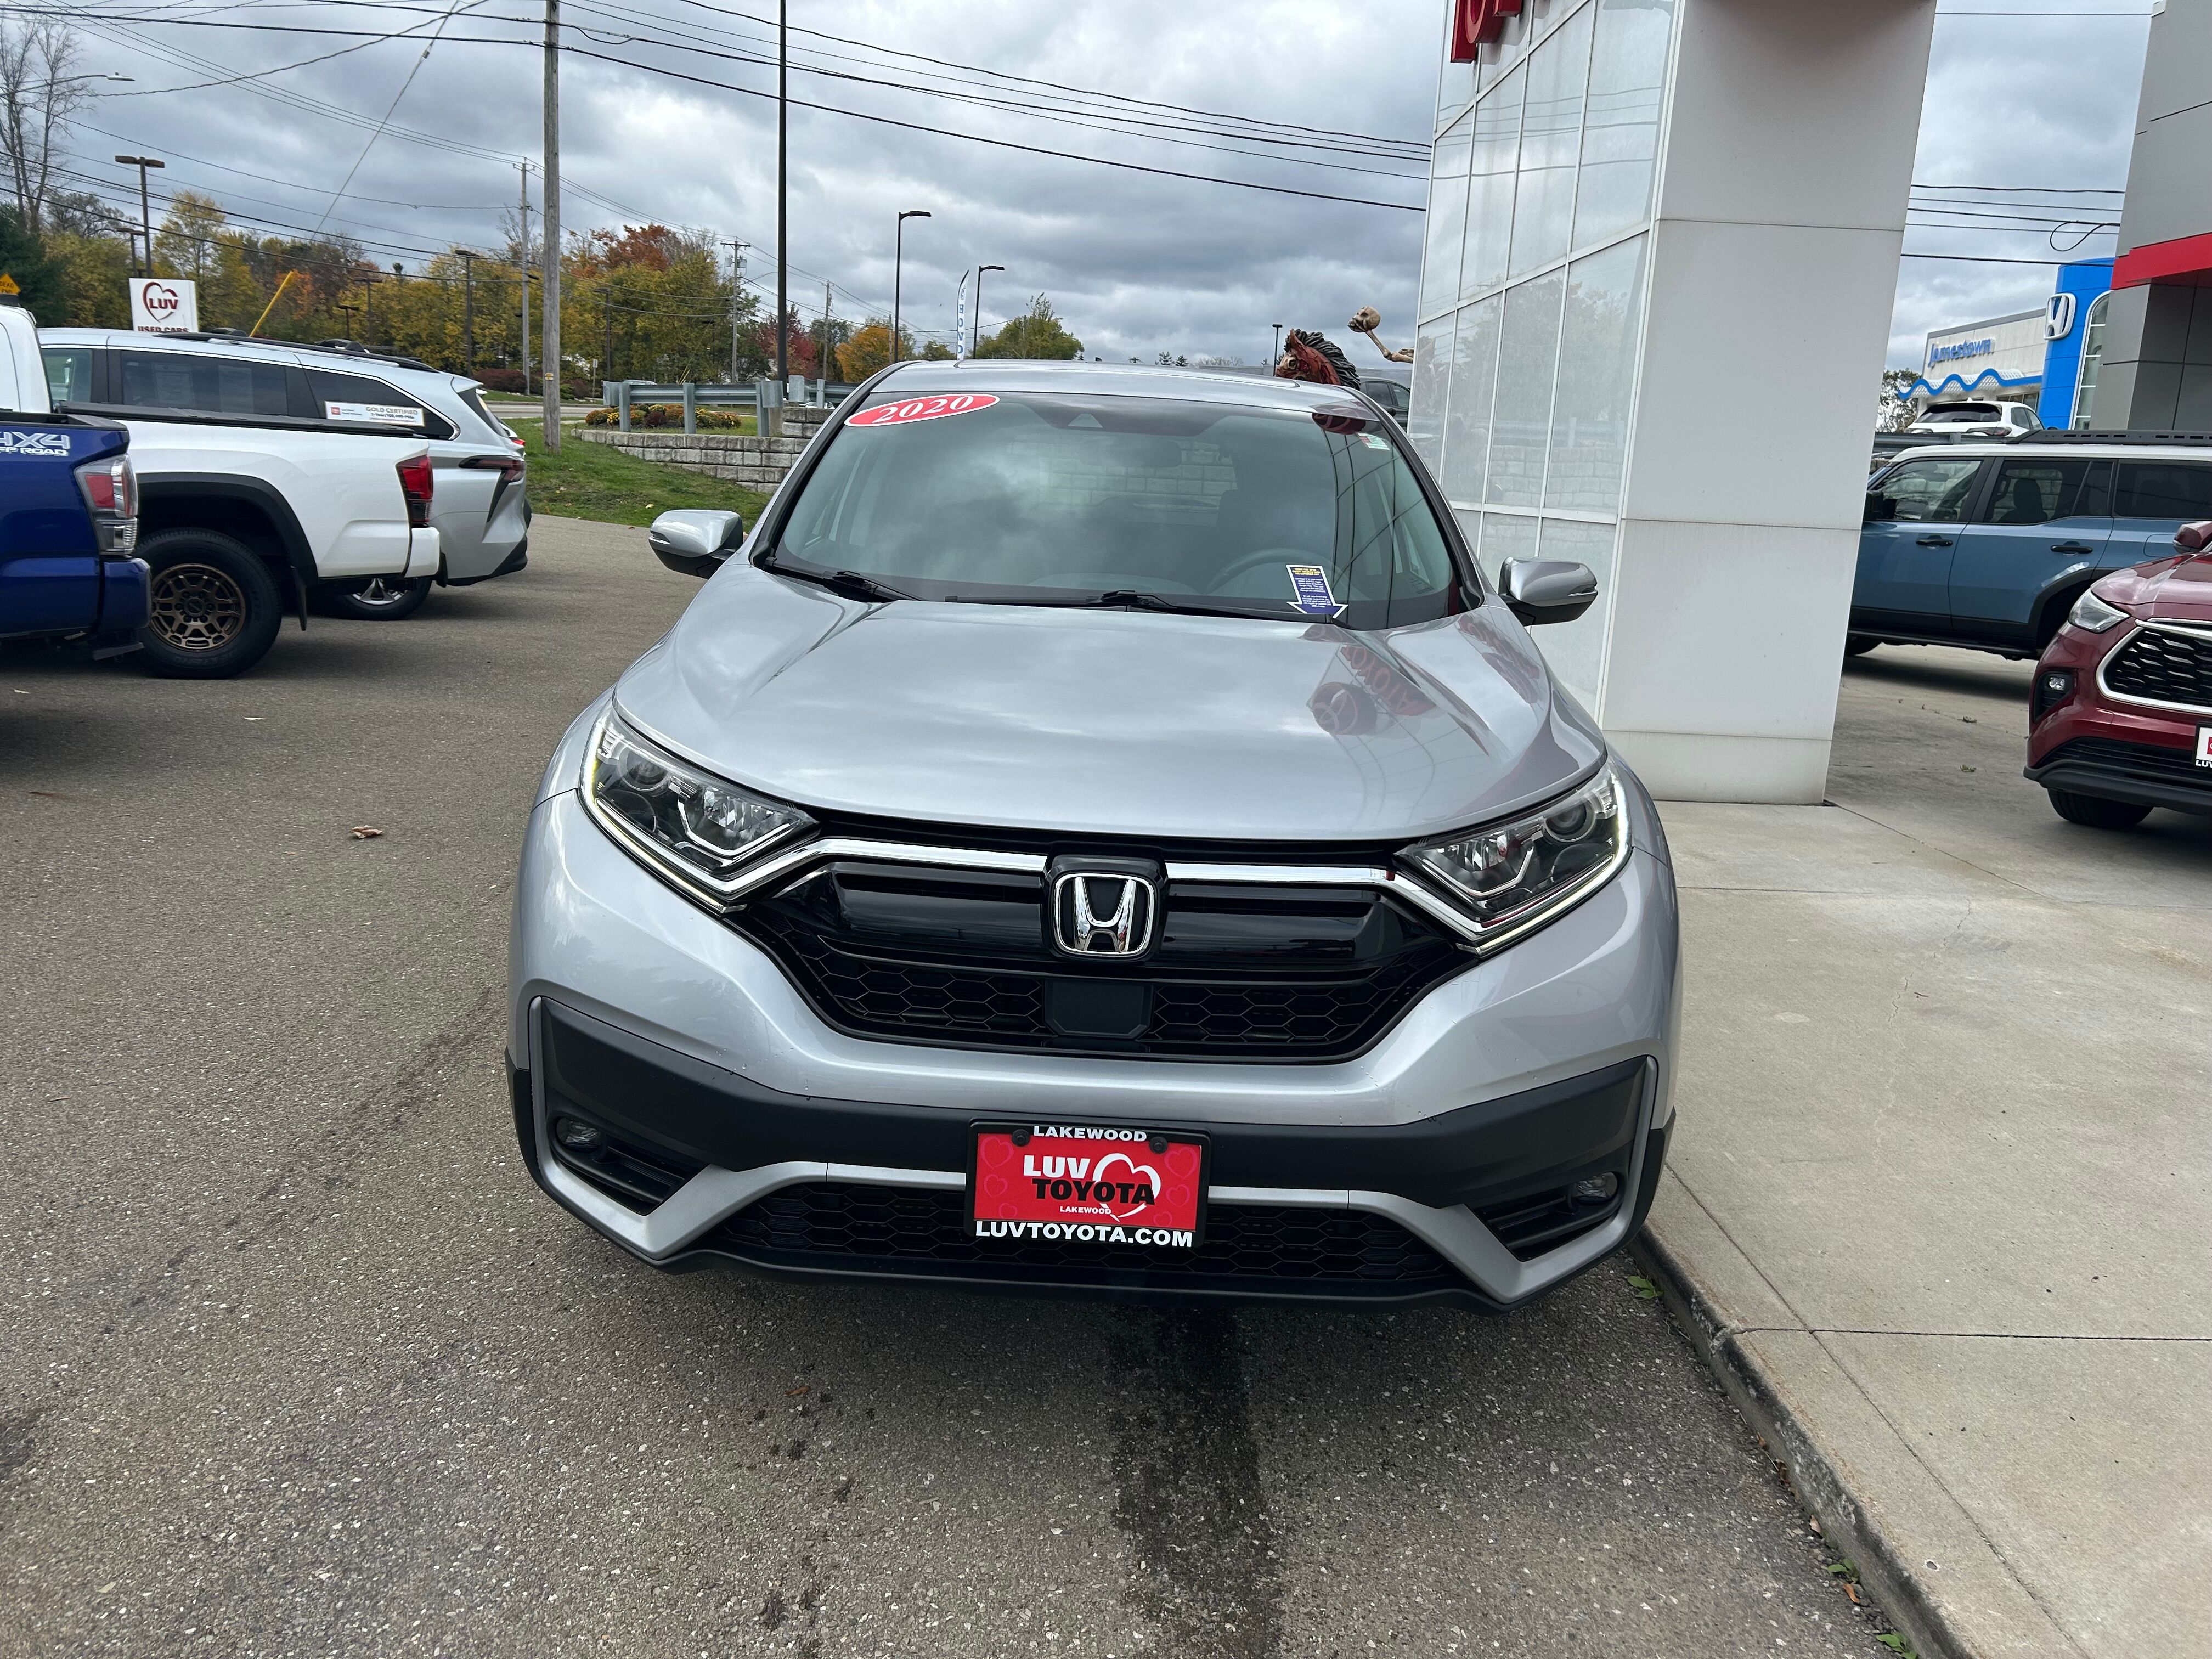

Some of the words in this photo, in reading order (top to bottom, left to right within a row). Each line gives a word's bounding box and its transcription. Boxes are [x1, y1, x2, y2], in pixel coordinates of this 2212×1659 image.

[149, 298, 178, 309] LUV
[1927, 338, 1993, 368] Jamestown
[871, 396, 974, 424] 2020
[20, 447, 69, 456] ROAD
[1034, 1125, 1147, 1142] LAKEWOOD
[1023, 1155, 1091, 1179] LUV
[1032, 1178, 1155, 1205] TOYOTA
[1059, 1205, 1112, 1215] LAKEWOOD
[975, 1220, 1192, 1248] LUVTOYOTA.COM
